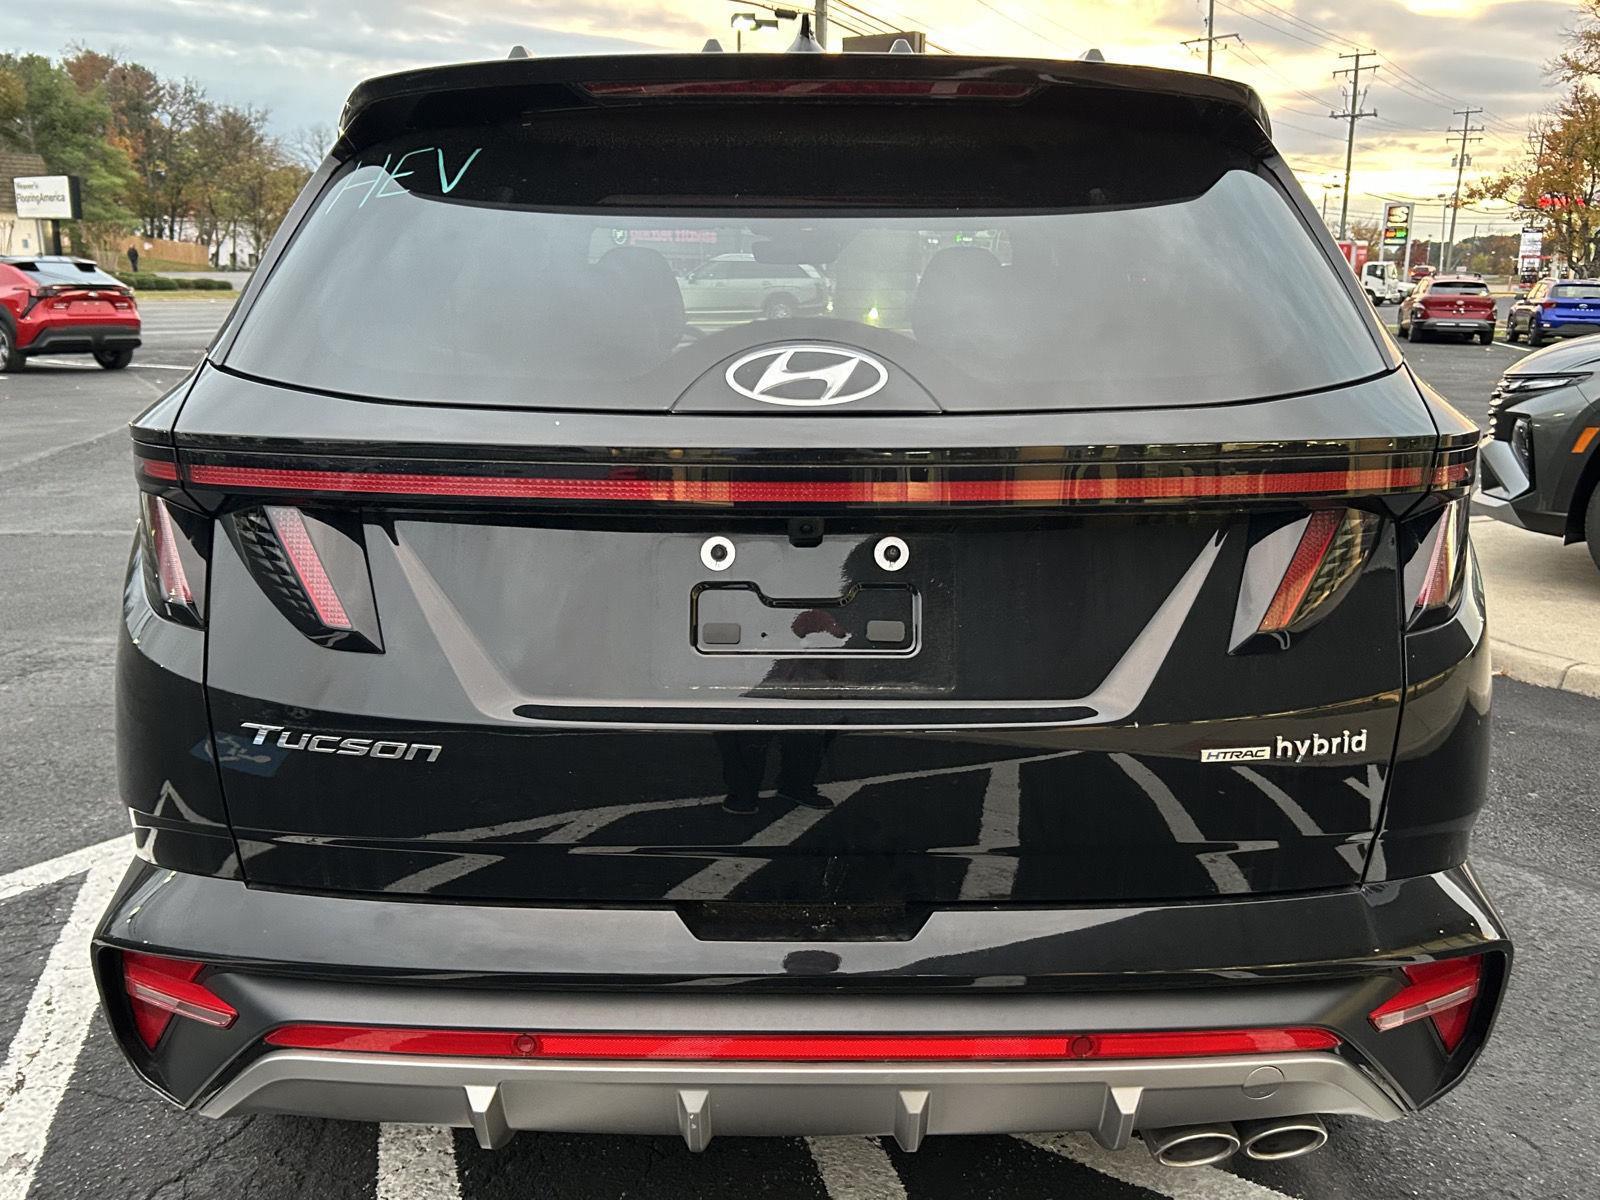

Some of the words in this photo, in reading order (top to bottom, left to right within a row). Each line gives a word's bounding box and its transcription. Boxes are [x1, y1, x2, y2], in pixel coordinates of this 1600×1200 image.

[326, 147, 482, 215] HEV
[1204, 748, 1268, 761] HTRAC
[1276, 729, 1367, 763] hybrid
